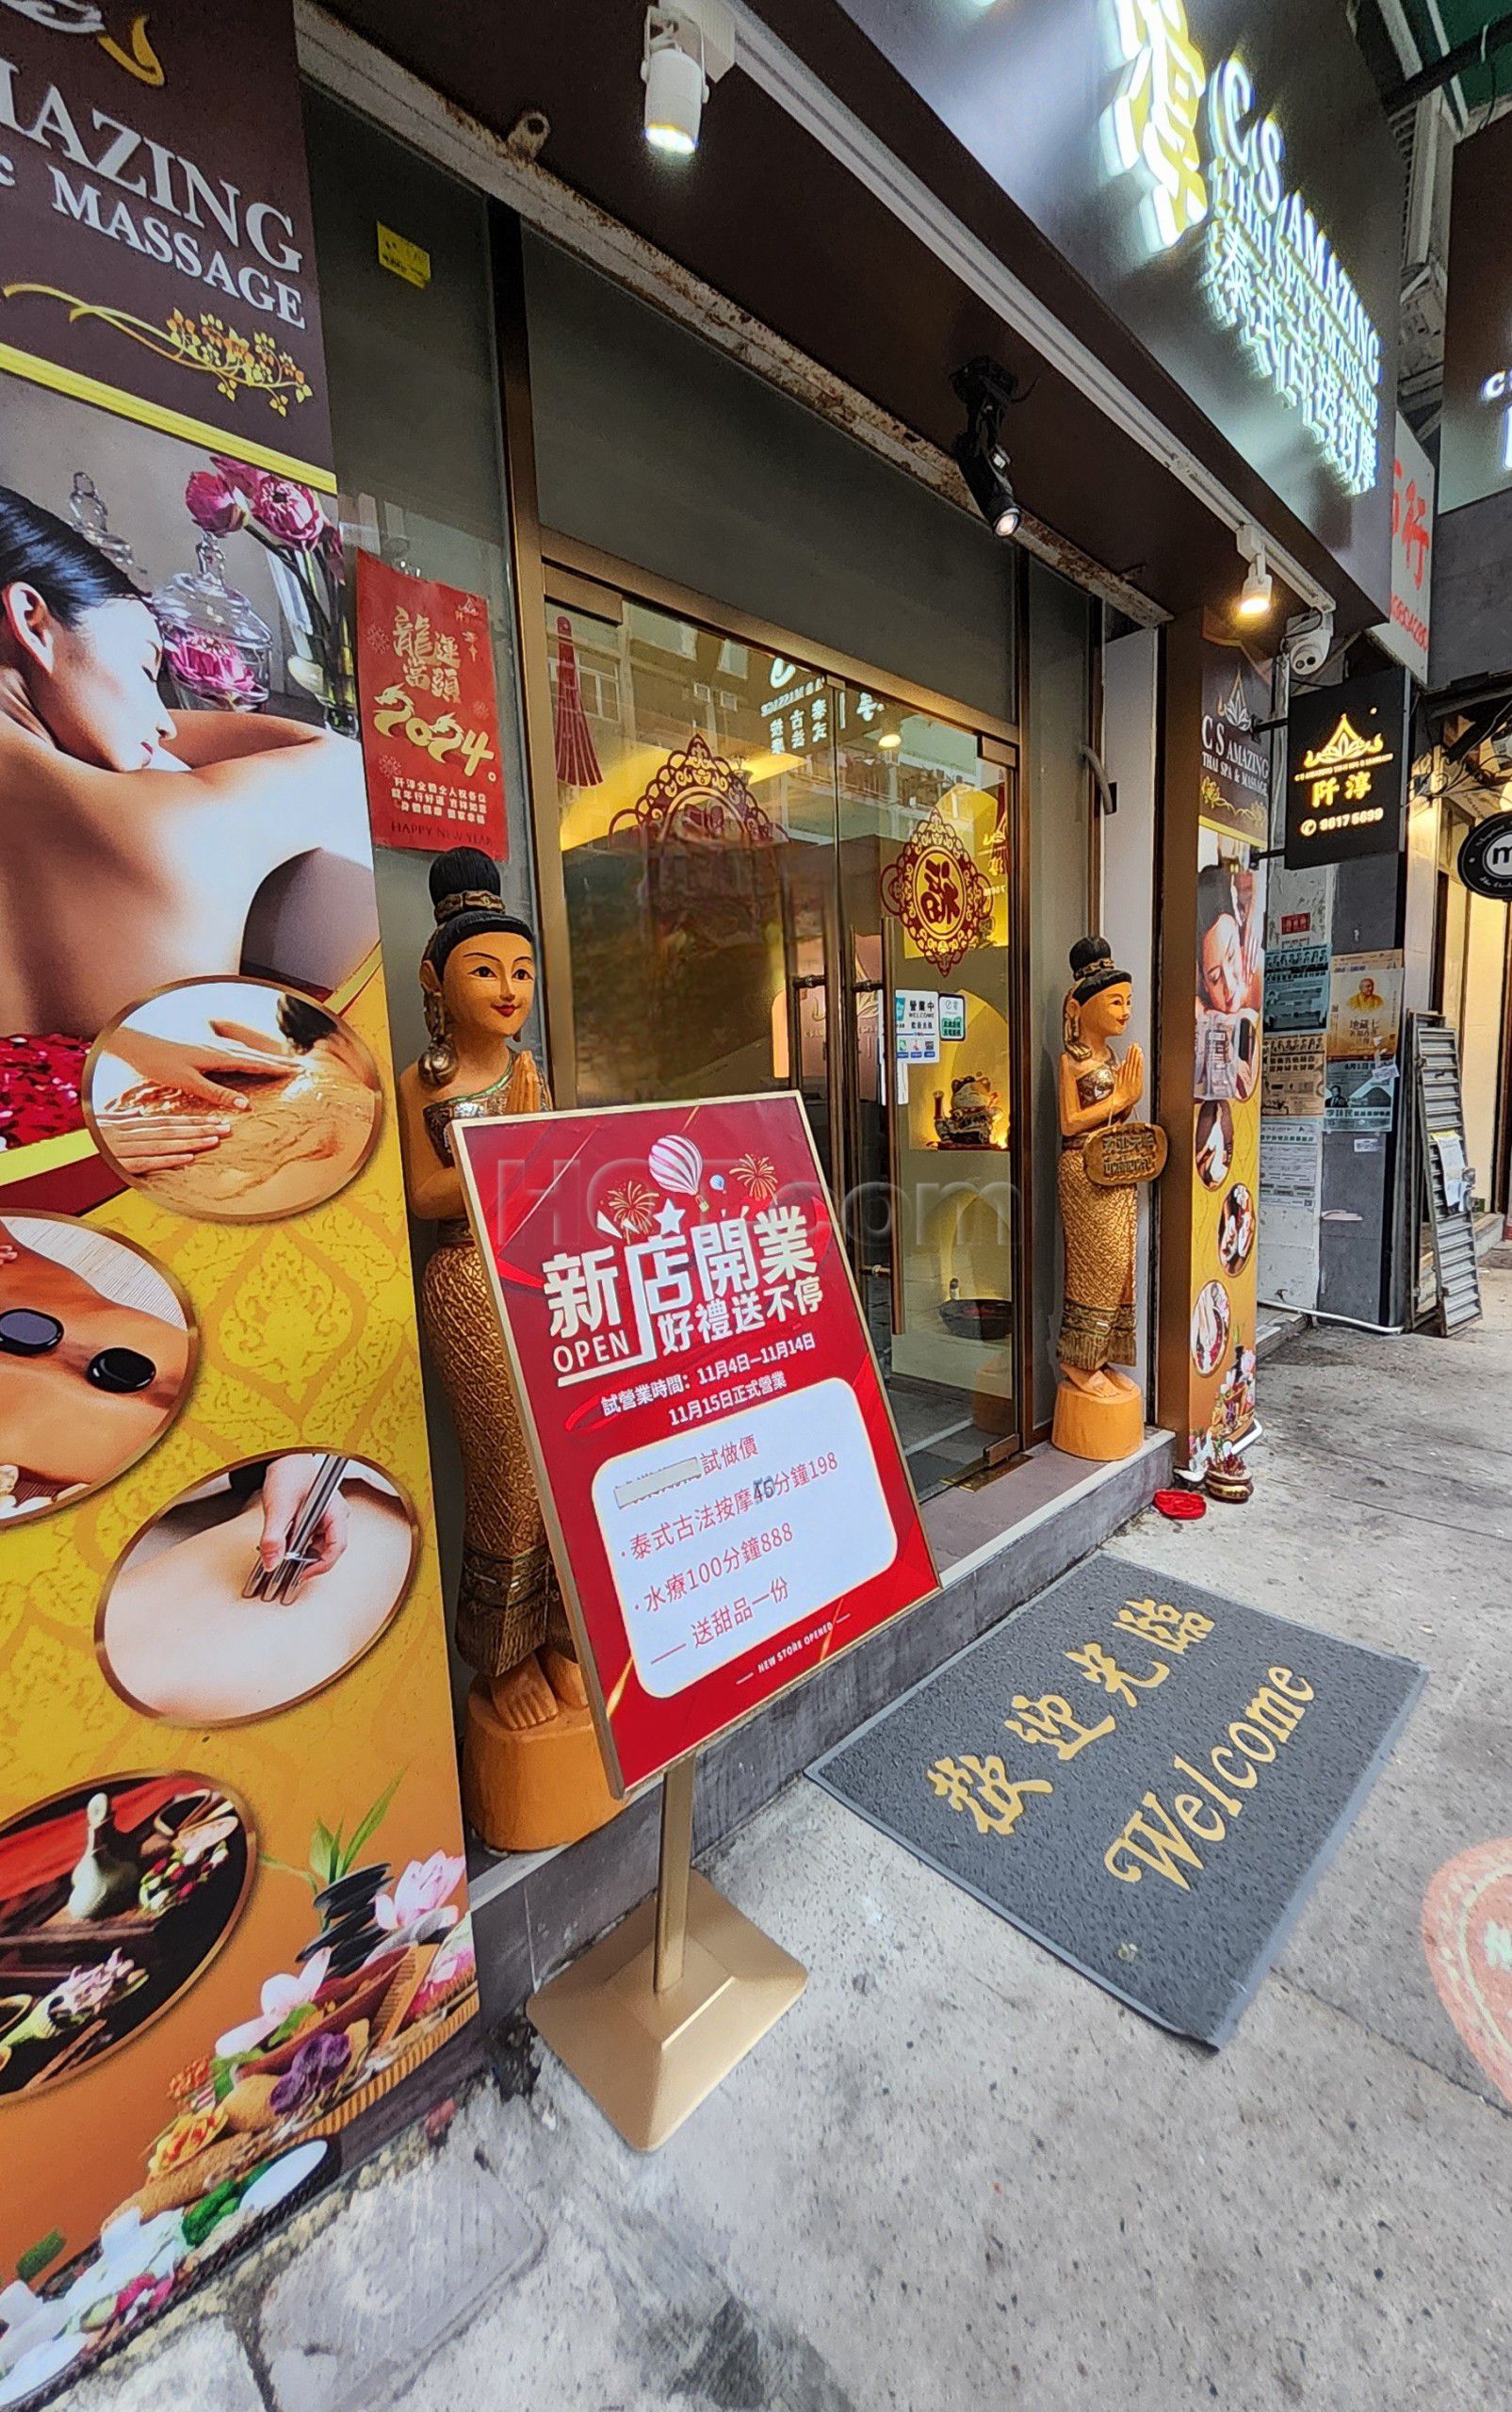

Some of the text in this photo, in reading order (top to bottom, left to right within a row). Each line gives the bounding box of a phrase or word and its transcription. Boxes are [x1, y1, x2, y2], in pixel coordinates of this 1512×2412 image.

[46, 162, 305, 329] MASSAGE
[1277, 189, 1381, 385] AMAZING
[1217, 160, 1272, 265] THAI
[1321, 302, 1379, 432] MASSAGE
[373, 682, 495, 777] 2024
[391, 821, 431, 836] HAPPY
[437, 829, 461, 840] NEW
[543, 1205, 819, 1340] 新店開業
[552, 1328, 630, 1373] OPEN
[657, 1276, 824, 1358] 好禮送不停
[668, 1371, 788, 1426] 11月15日正式營業
[691, 1575, 790, 1649] 送甜品一份
[757, 1622, 834, 1674] NEW STORE OPENED
[1104, 1665, 1316, 1892] Welcome
